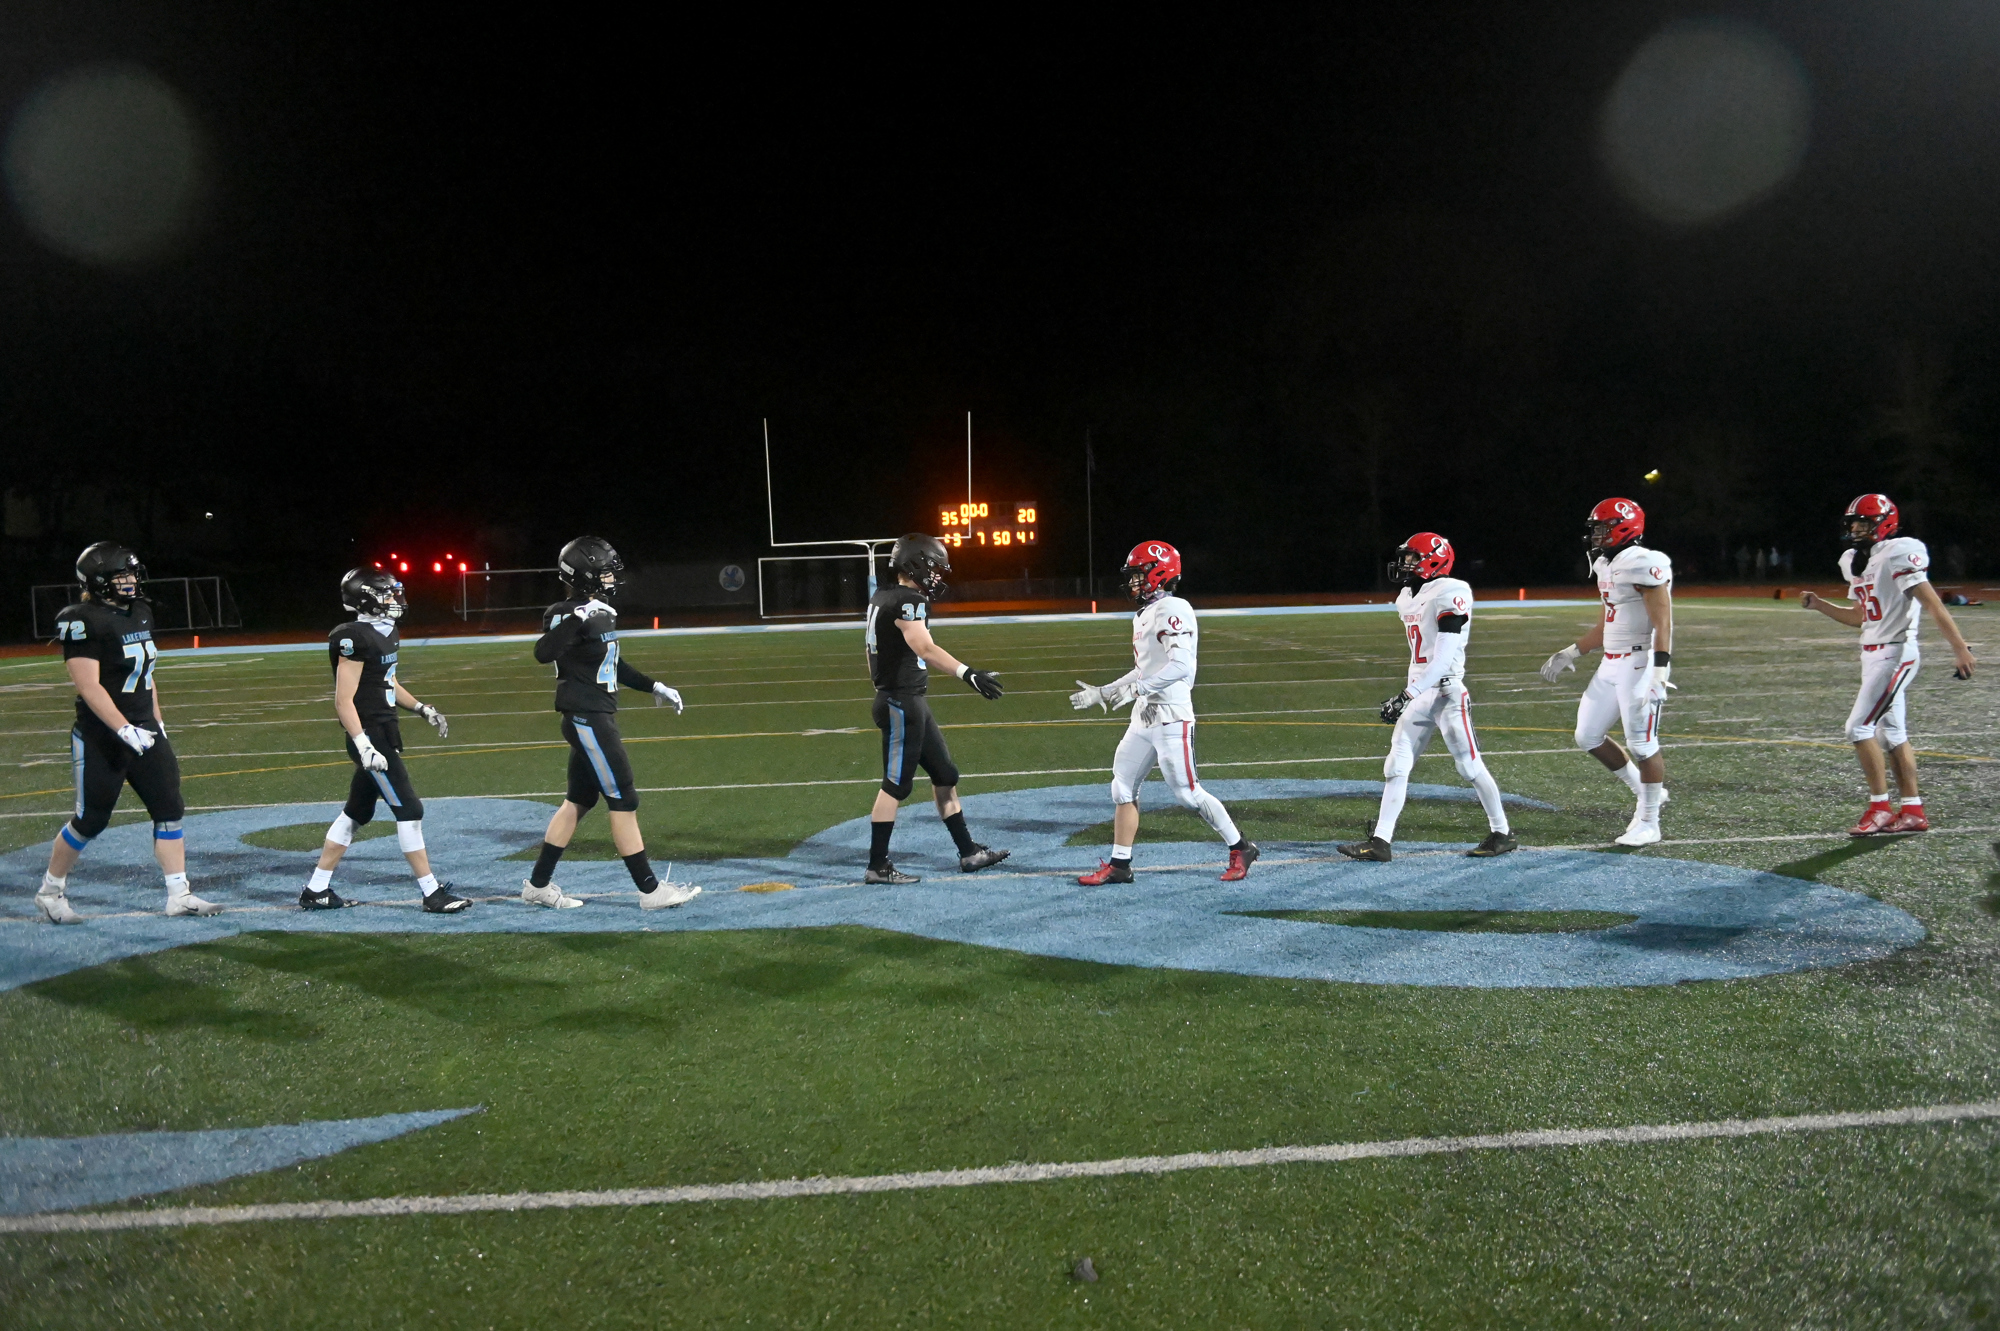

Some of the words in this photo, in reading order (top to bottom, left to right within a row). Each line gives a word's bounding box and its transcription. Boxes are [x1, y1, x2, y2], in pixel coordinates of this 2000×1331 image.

[941, 511, 959, 526] 35
[1017, 508, 1036, 523] 20
[992, 530, 1011, 545] 50
[1147, 544, 1171, 562] OC
[901, 602, 926, 621] 34
[57, 620, 87, 641] 72
[1167, 615, 1183, 631] OC
[339, 638, 354, 656] 3
[1407, 624, 1427, 664] 12
[121, 640, 158, 693] 72
